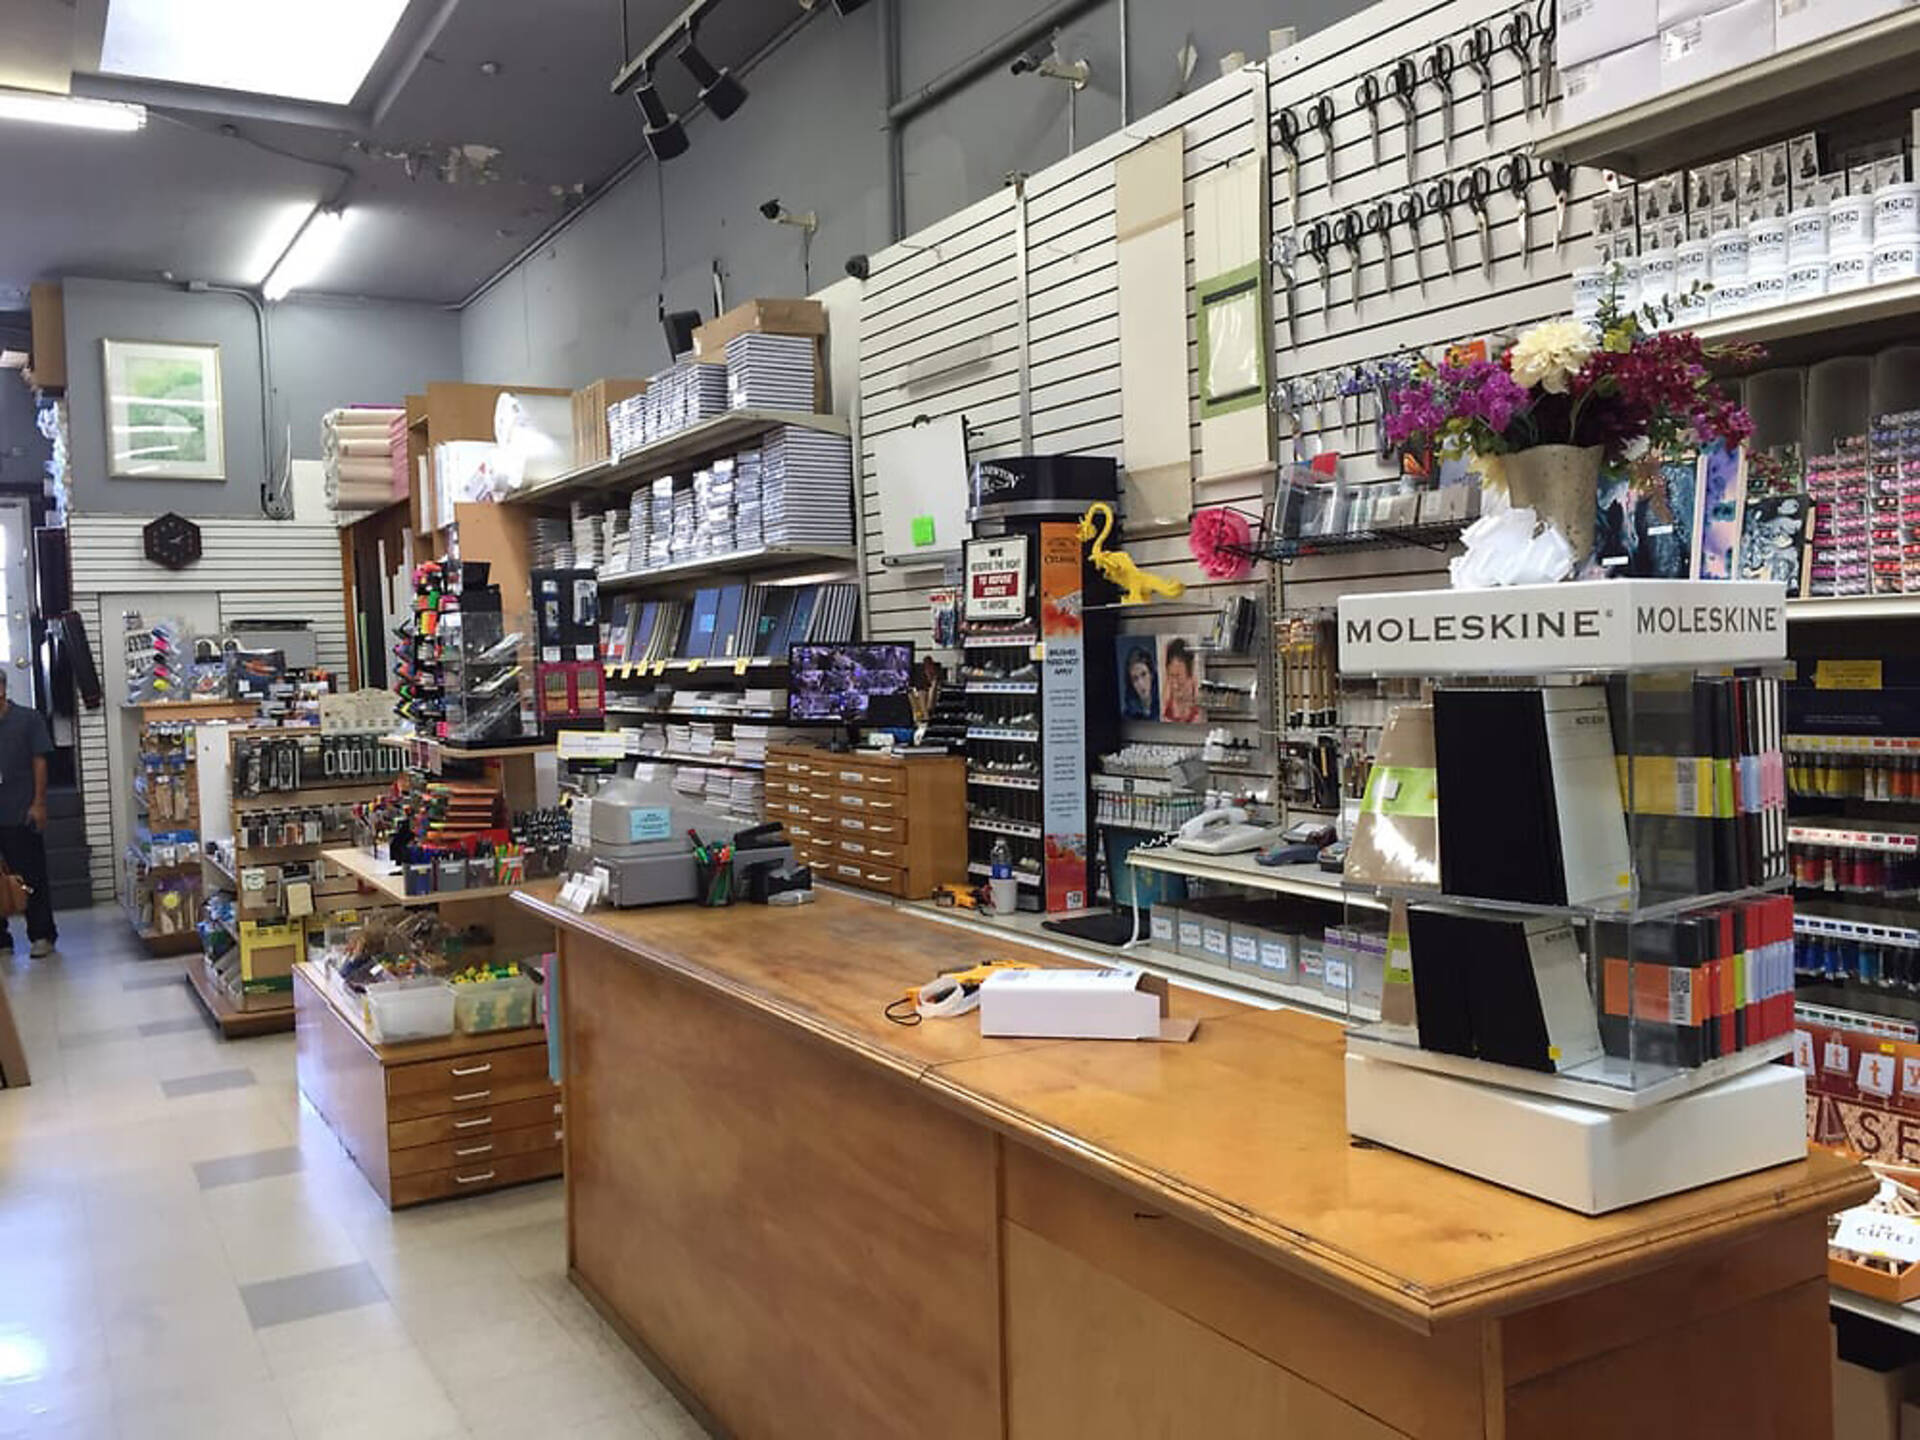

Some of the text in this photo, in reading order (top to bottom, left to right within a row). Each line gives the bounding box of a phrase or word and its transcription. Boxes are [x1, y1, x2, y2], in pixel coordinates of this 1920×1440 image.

[1347, 610, 1600, 643] MOLESKINE
[1637, 606, 1777, 634] MOLESKINE
[1806, 1094, 1920, 1164] ASE
